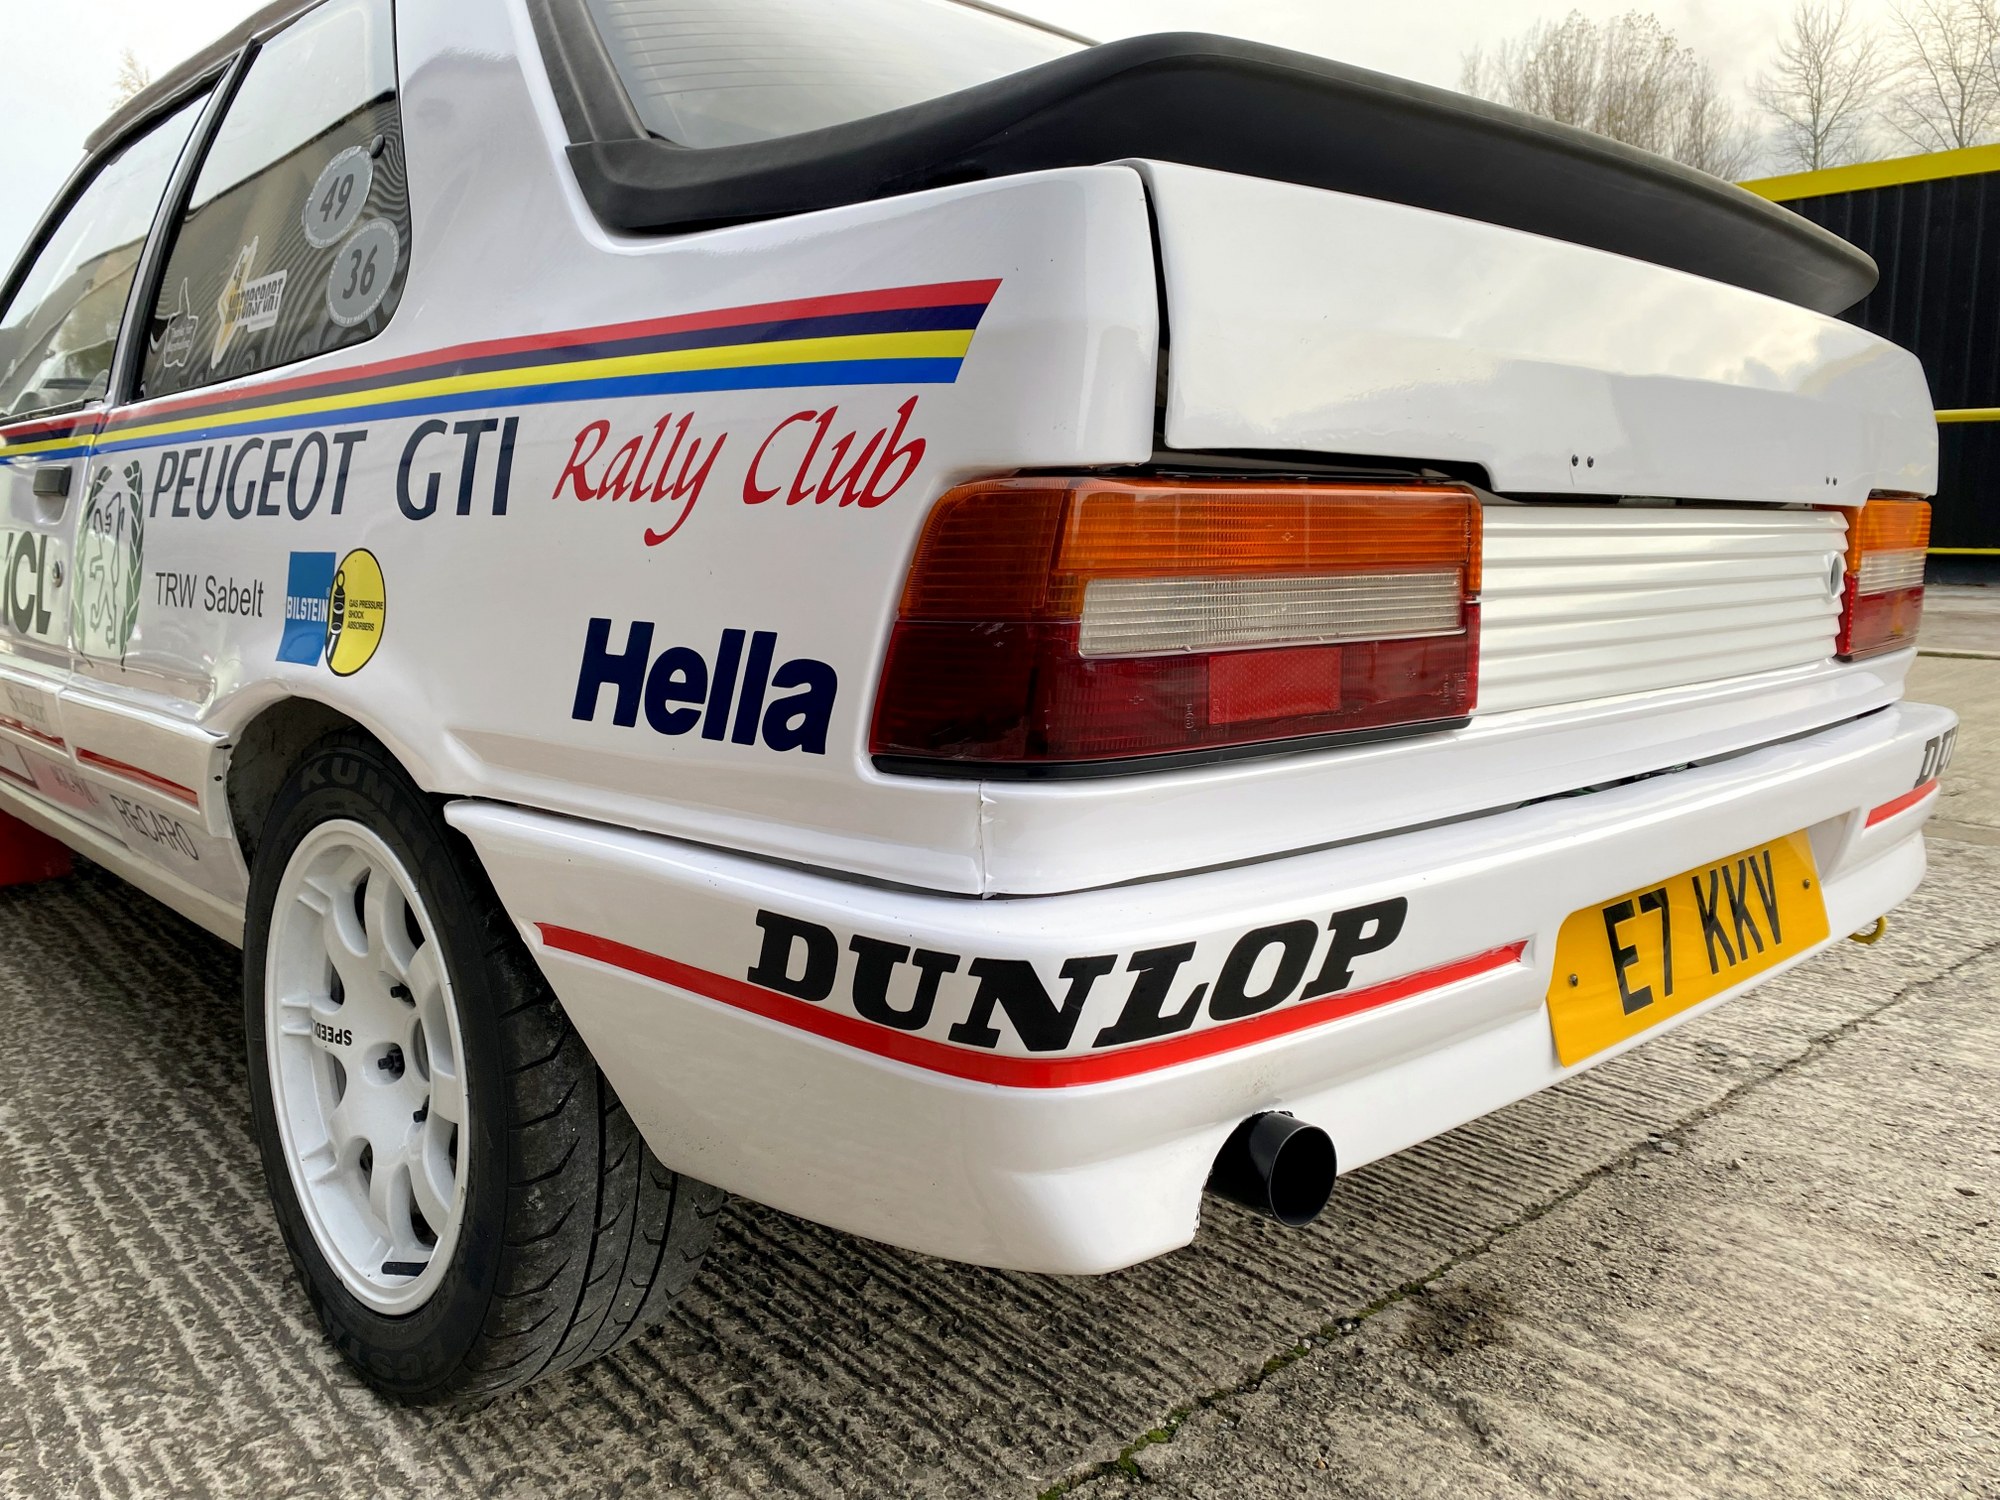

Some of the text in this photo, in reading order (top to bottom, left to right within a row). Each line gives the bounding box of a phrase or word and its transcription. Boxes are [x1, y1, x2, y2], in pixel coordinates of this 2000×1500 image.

[319, 173, 354, 222] 49
[342, 244, 378, 299] 36
[149, 416, 520, 521] PEUGEOT GTI
[552, 395, 926, 547] Rally Club
[155, 572, 264, 618] TRW Sabelt
[286, 595, 329, 623] BILSTEIN
[348, 599, 384, 610] GAS PRESSURE
[348, 610, 365, 620] SHOCK
[346, 621, 375, 632] ABSORBERS
[571, 617, 838, 755] Hella
[109, 793, 200, 862] RECARO
[1601, 849, 1782, 1016] E7 KKV
[746, 896, 1408, 1052] DUNLOP
